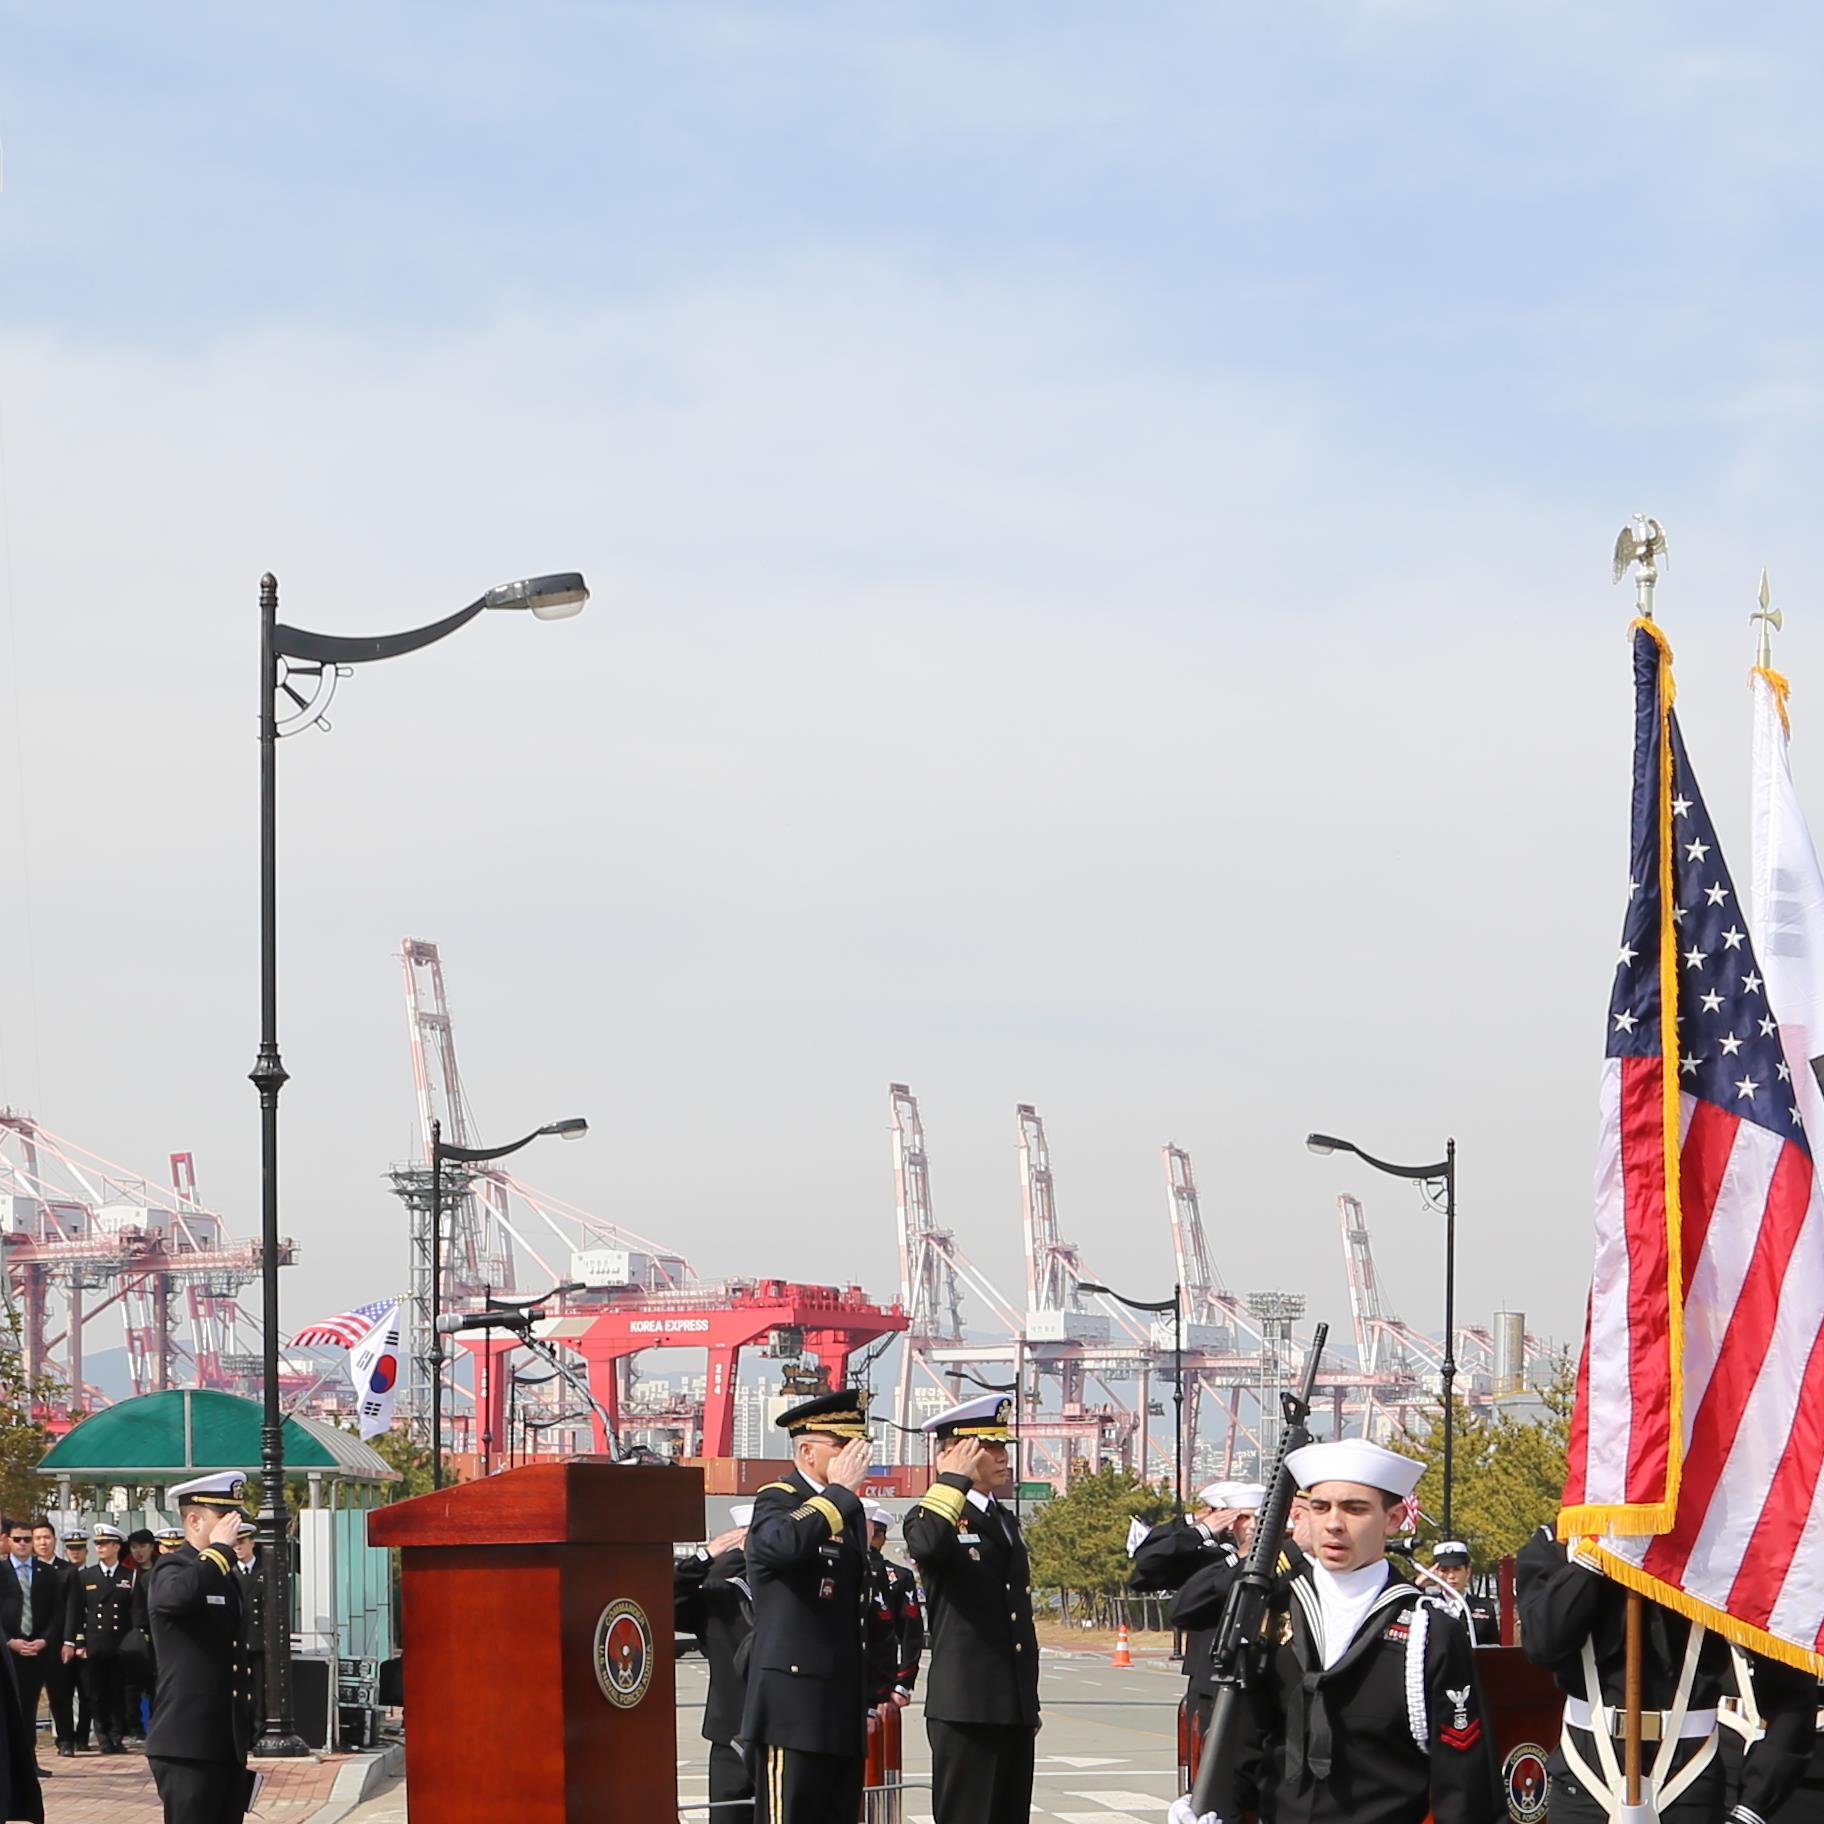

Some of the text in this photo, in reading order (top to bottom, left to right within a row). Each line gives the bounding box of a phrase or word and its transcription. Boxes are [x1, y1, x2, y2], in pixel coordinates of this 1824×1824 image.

[629, 1319, 709, 1333] KOREA EXPRESS
[714, 1363, 723, 1395] 254
[865, 1485, 896, 1497] CK LINE
